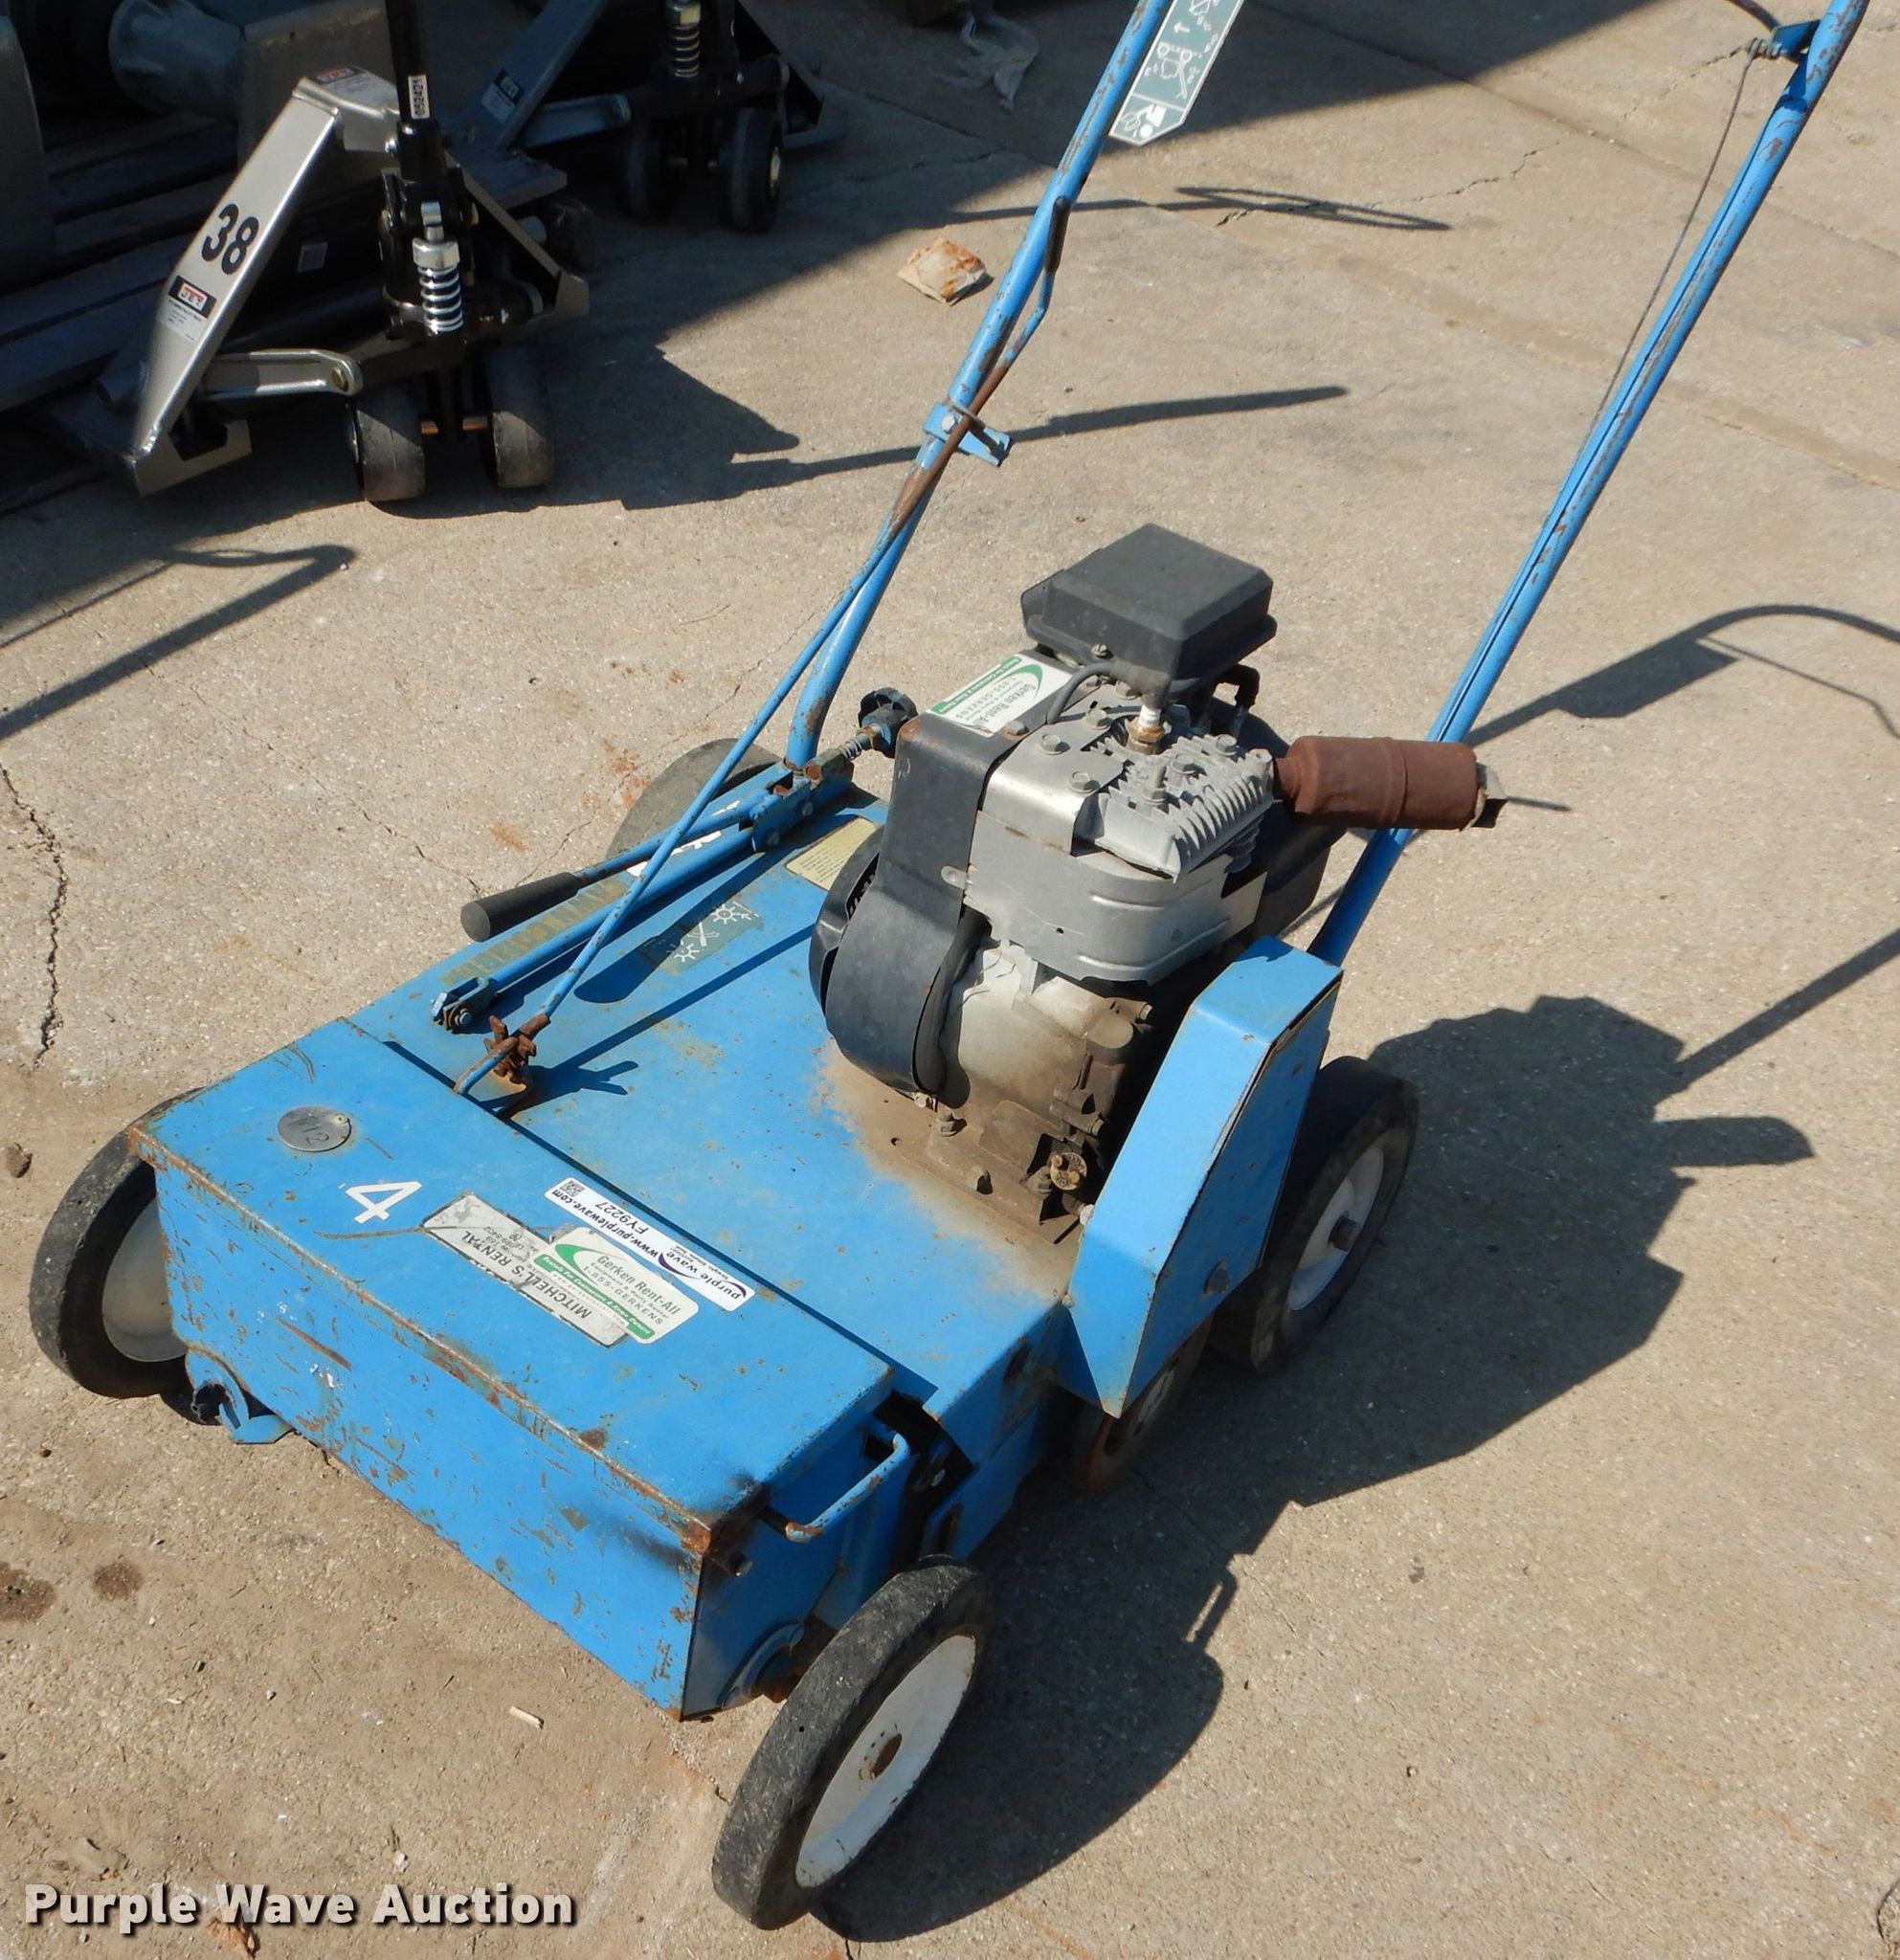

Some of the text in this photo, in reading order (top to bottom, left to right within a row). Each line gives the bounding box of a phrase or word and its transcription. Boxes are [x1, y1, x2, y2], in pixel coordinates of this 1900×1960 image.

[201, 203, 260, 276] 38
[179, 285, 206, 309] JET
[346, 1181, 422, 1224] 4
[548, 1189, 660, 1258] www.purplewave.com
[594, 1199, 650, 1235] FY9227
[509, 1263, 593, 1319] MITCHELL'S
[581, 1265, 665, 1325] 1-855-GERKENS
[596, 1254, 637, 1284] Gerken
[633, 1281, 682, 1315] Rent-All
[663, 1251, 742, 1301] purple wave
